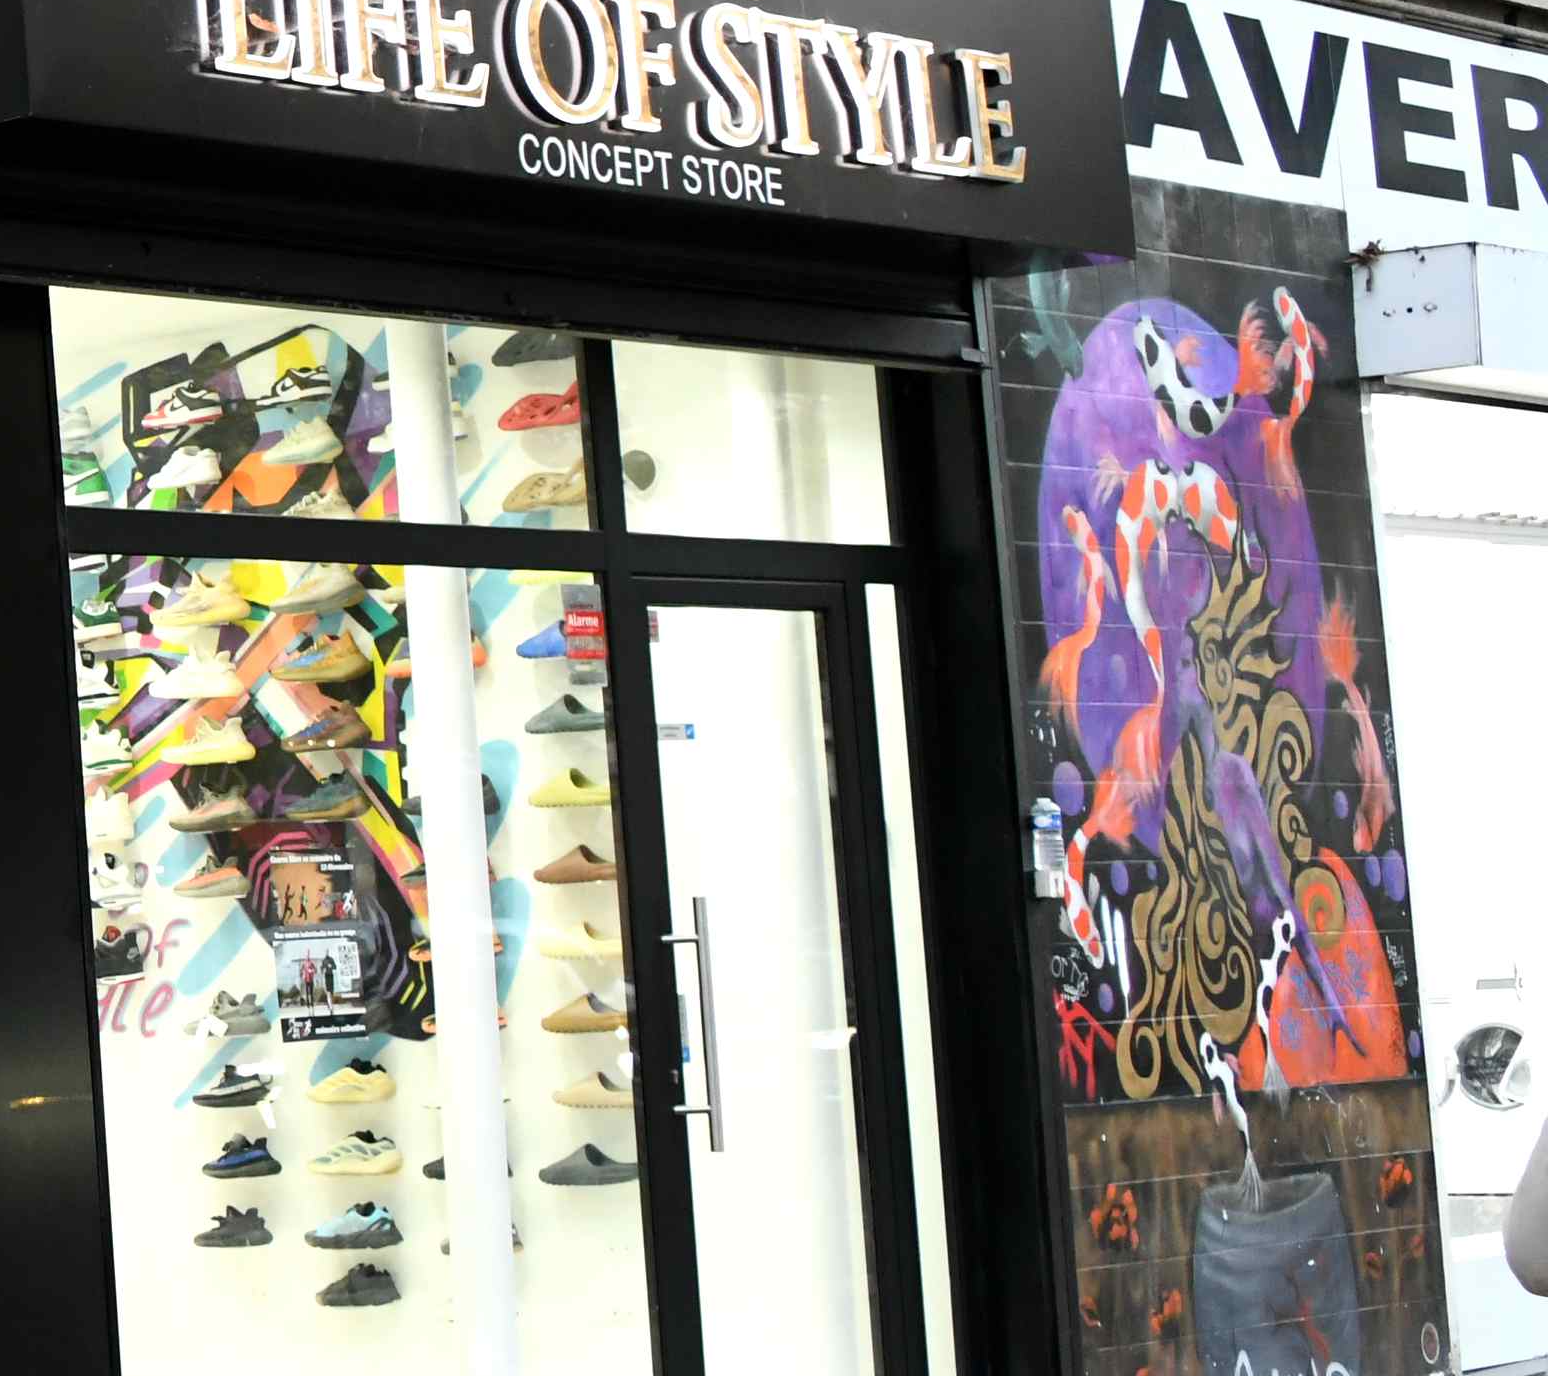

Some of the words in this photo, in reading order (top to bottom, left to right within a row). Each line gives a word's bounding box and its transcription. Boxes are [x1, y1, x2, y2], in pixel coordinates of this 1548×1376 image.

[687, 0, 1027, 183] STYLE
[518, 133, 674, 189] CONCEPT
[681, 153, 786, 206] STORE
[568, 614, 599, 626] Alarme
